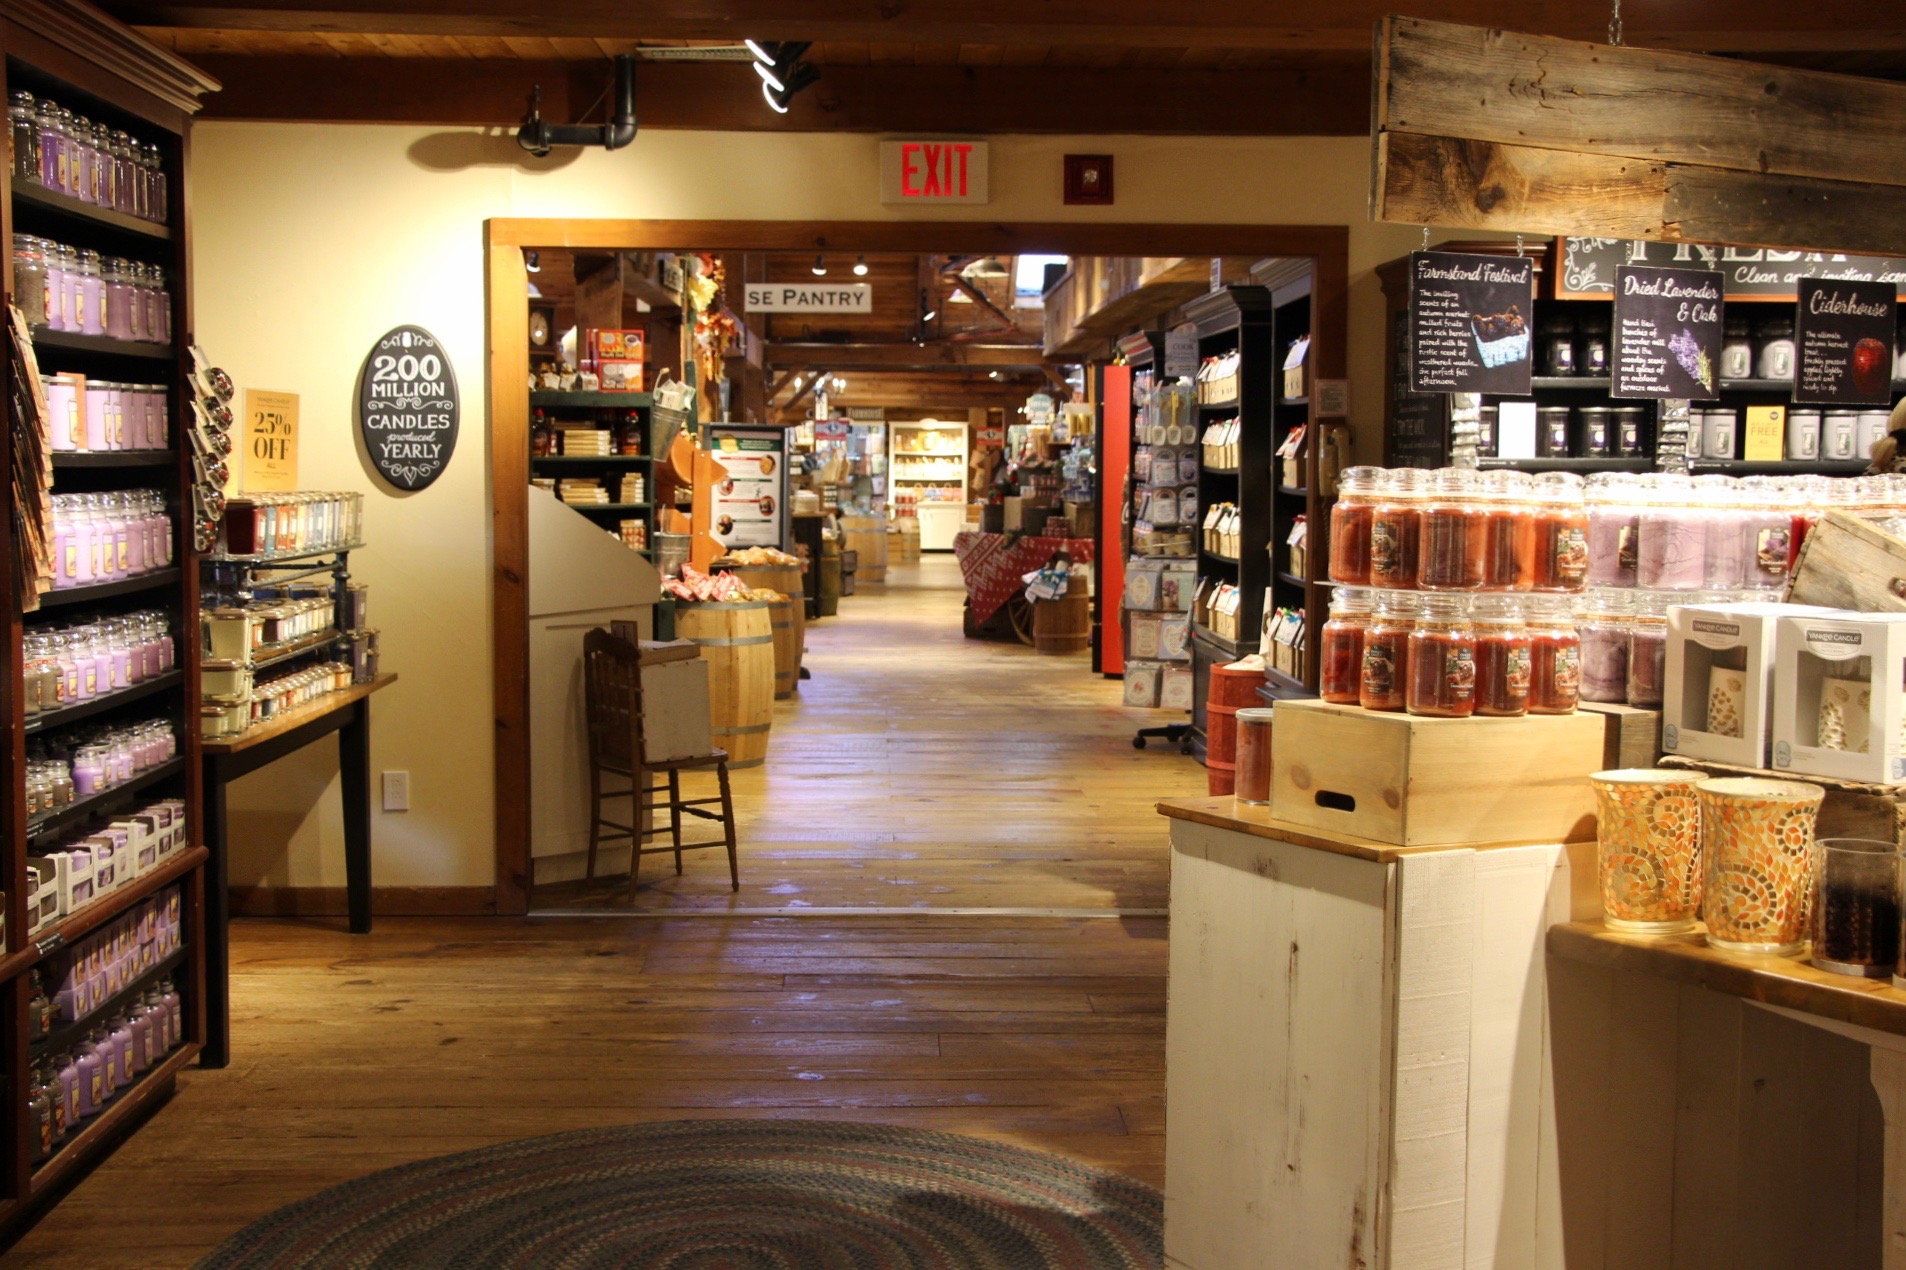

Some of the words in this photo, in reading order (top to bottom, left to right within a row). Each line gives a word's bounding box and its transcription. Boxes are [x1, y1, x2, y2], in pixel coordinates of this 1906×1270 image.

[902, 143, 973, 197] EXIT
[1418, 260, 1483, 281] Farmstand
[1484, 263, 1530, 284] Festival
[1735, 266, 1779, 284] Clean
[1624, 275, 1661, 296] Dried
[1660, 277, 1719, 300] Lavender
[749, 291, 773, 305] SE
[782, 289, 864, 306] PANTRY
[1440, 299, 1448, 308] of
[1810, 289, 1888, 318] Ciderhouse
[1676, 301, 1690, 322] &
[1691, 303, 1718, 323] Oak
[1623, 318, 1639, 326] Hand
[1449, 328, 1471, 337] berries
[1623, 326, 1648, 336] bunches
[1648, 327, 1658, 338] of
[1419, 338, 1440, 348] paired
[1622, 336, 1650, 345] lavender
[1458, 348, 1467, 357] of
[373, 354, 442, 382] 200
[1432, 367, 1453, 378] perfect
[1621, 364, 1634, 372] and
[1655, 364, 1664, 375] of
[371, 382, 446, 398] MILLION
[253, 411, 292, 436] 25%
[367, 414, 451, 430] CANDLES
[386, 430, 437, 446] produced
[1750, 427, 1779, 437] FREE
[253, 436, 291, 460] OFF
[379, 443, 443, 459] YEARLY
